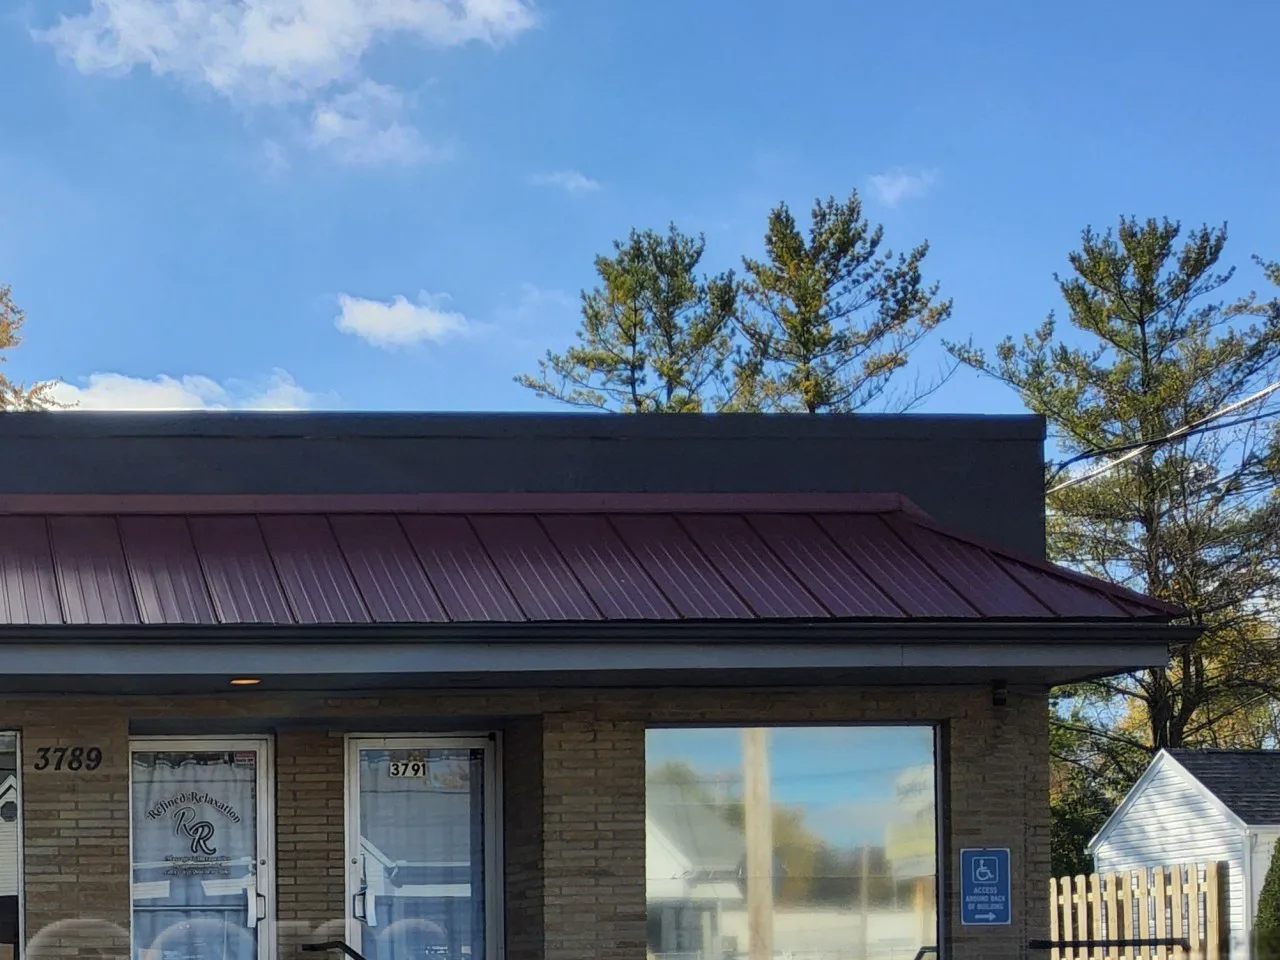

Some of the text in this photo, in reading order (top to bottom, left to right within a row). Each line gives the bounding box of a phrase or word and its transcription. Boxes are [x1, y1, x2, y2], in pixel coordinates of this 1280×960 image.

[34, 747, 102, 771] 3789
[391, 761, 427, 777] 3791
[147, 791, 242, 824] Refined Relaxation
[973, 886, 998, 894] ACCESS
